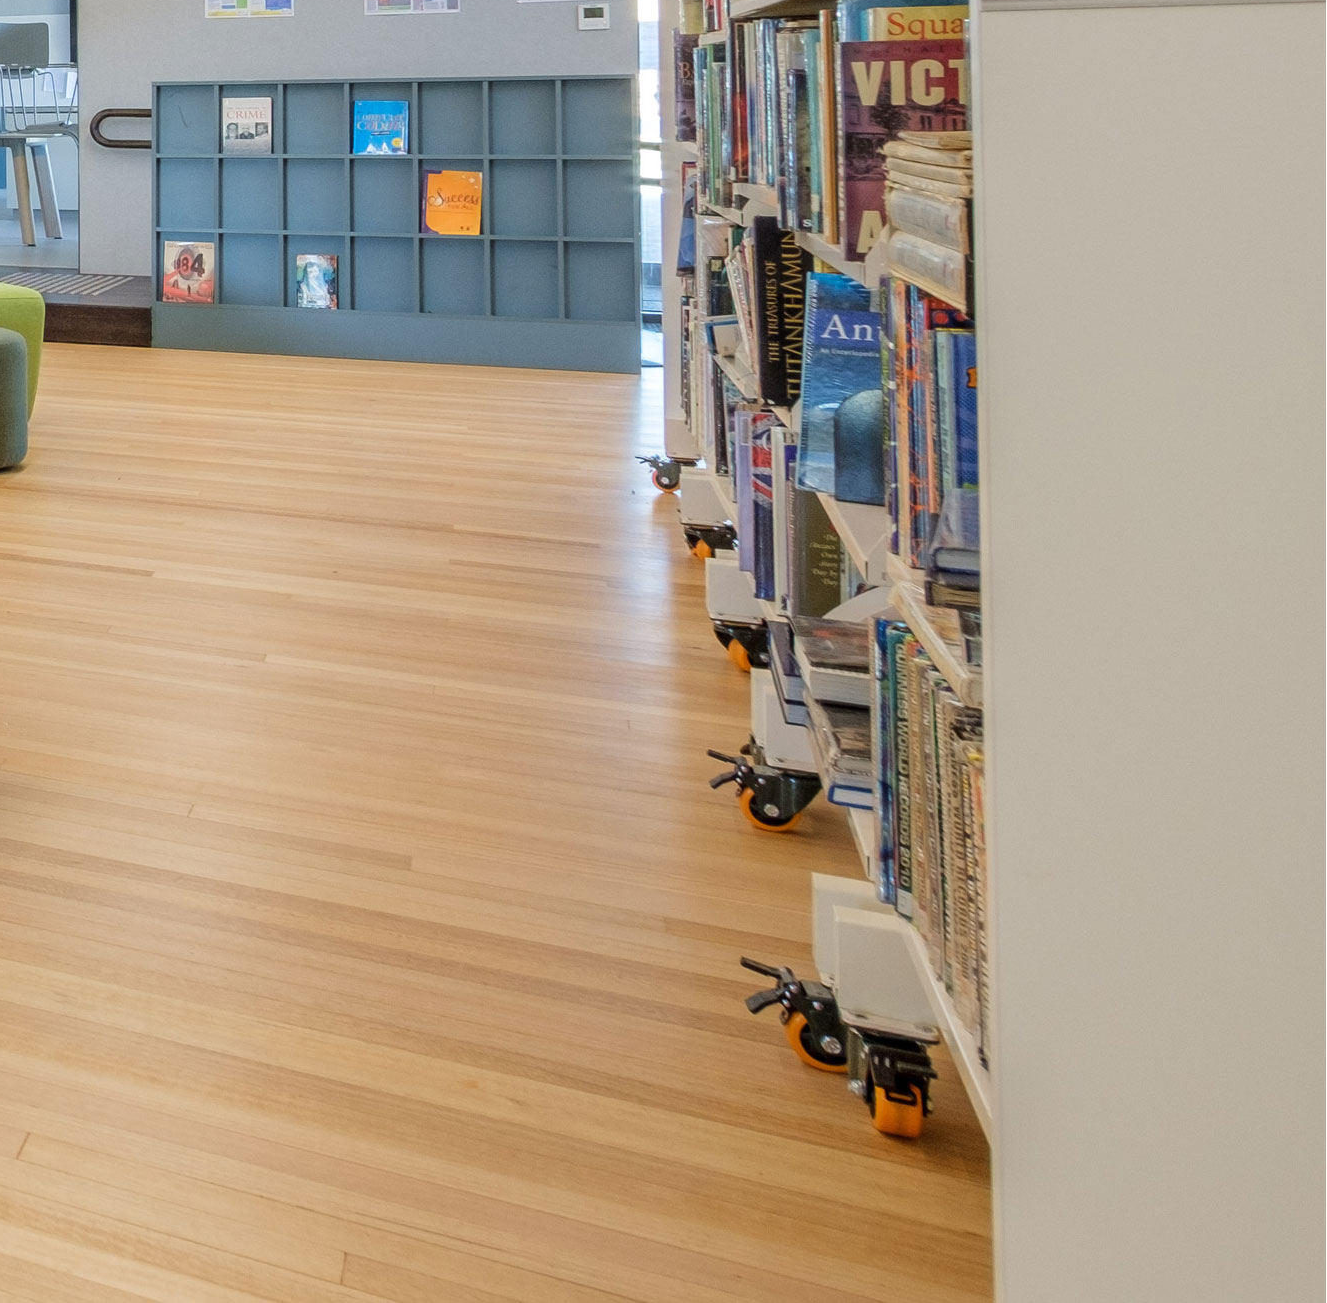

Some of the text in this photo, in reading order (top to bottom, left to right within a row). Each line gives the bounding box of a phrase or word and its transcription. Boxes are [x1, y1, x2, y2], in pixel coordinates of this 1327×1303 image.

[226, 110, 266, 120] CRIME
[765, 260, 780, 363] THE TREASURES OF
[820, 314, 882, 343] An
[895, 644, 911, 887] GUINNESS WORLD RECORDS 2010
